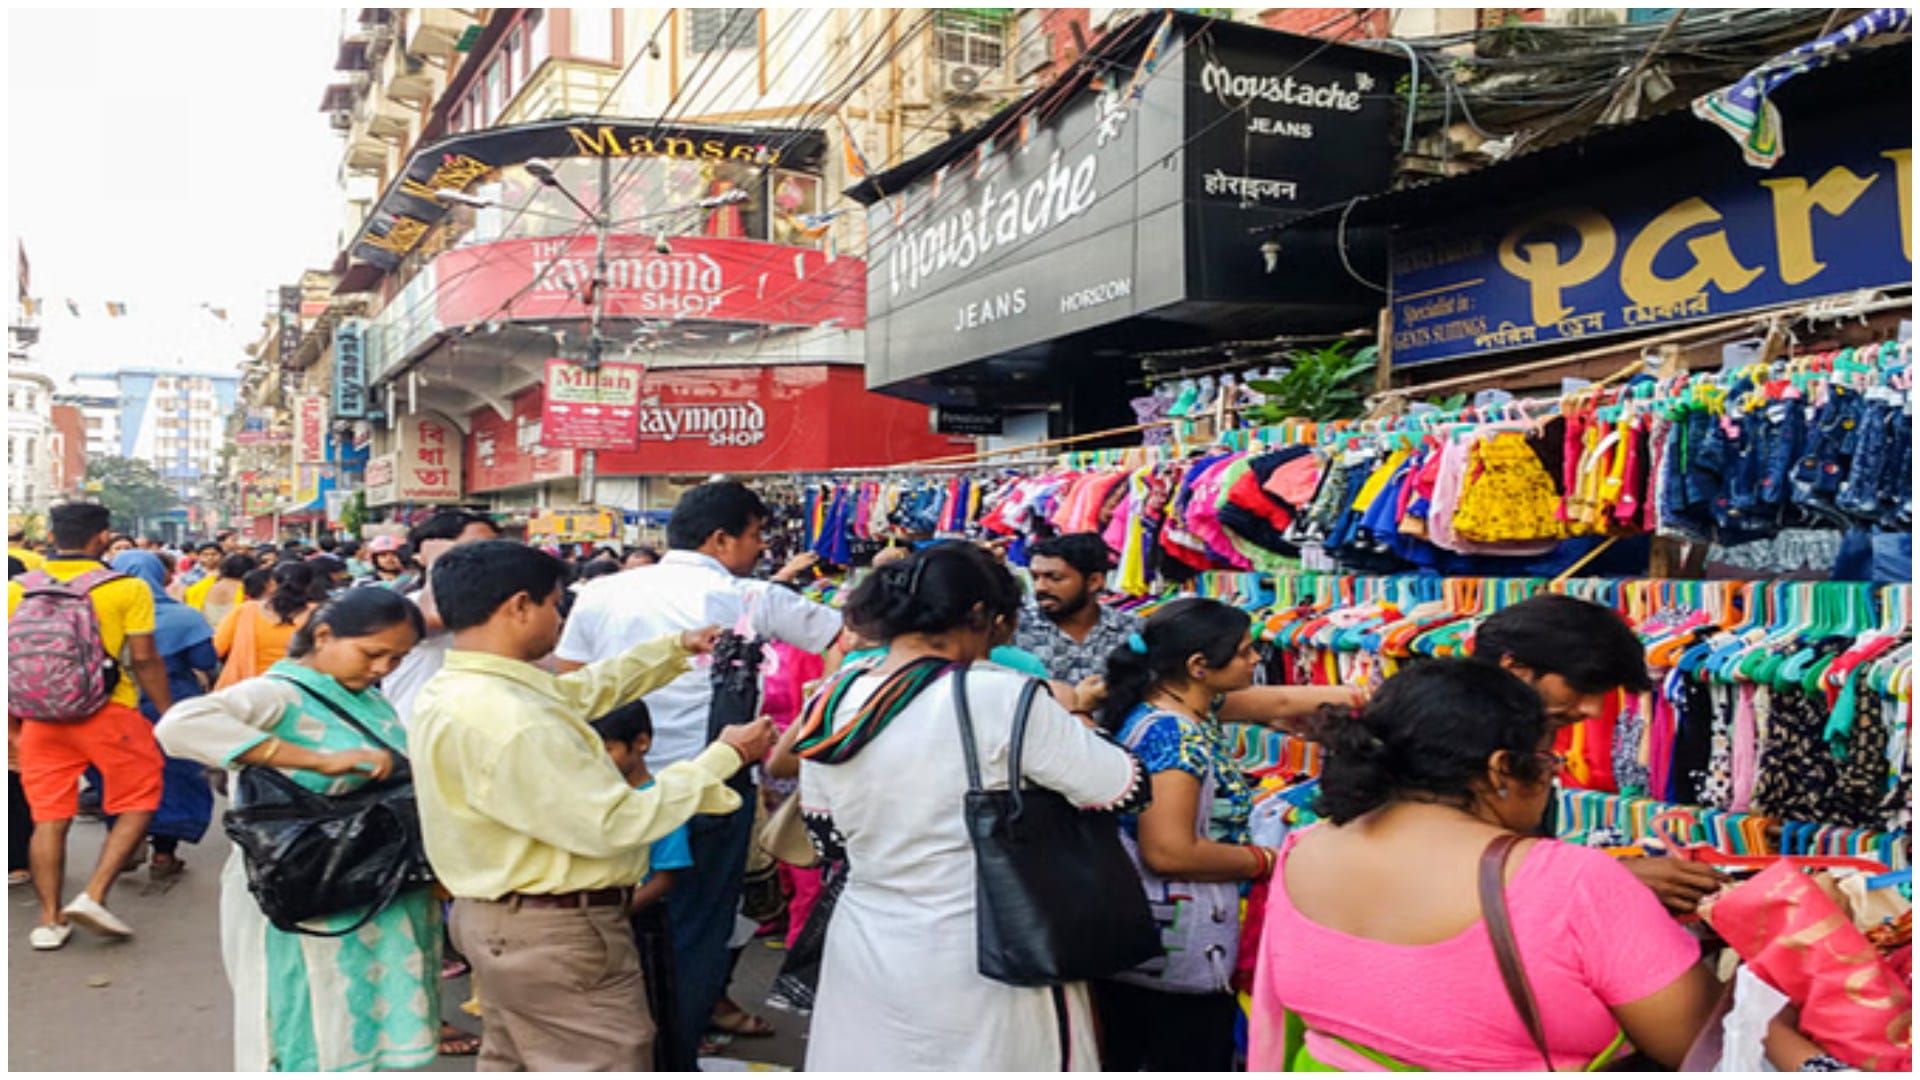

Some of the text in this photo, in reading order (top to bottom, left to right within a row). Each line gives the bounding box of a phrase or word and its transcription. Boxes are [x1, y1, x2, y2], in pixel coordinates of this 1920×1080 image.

[1202, 62, 1361, 111] Moustache
[1247, 117, 1313, 139] JEANS
[890, 149, 1097, 296] Moustache
[641, 291, 723, 313] SHOP
[953, 287, 1026, 331] JEANS
[1061, 277, 1131, 313] HORIZON
[708, 431, 766, 447] SHOP
